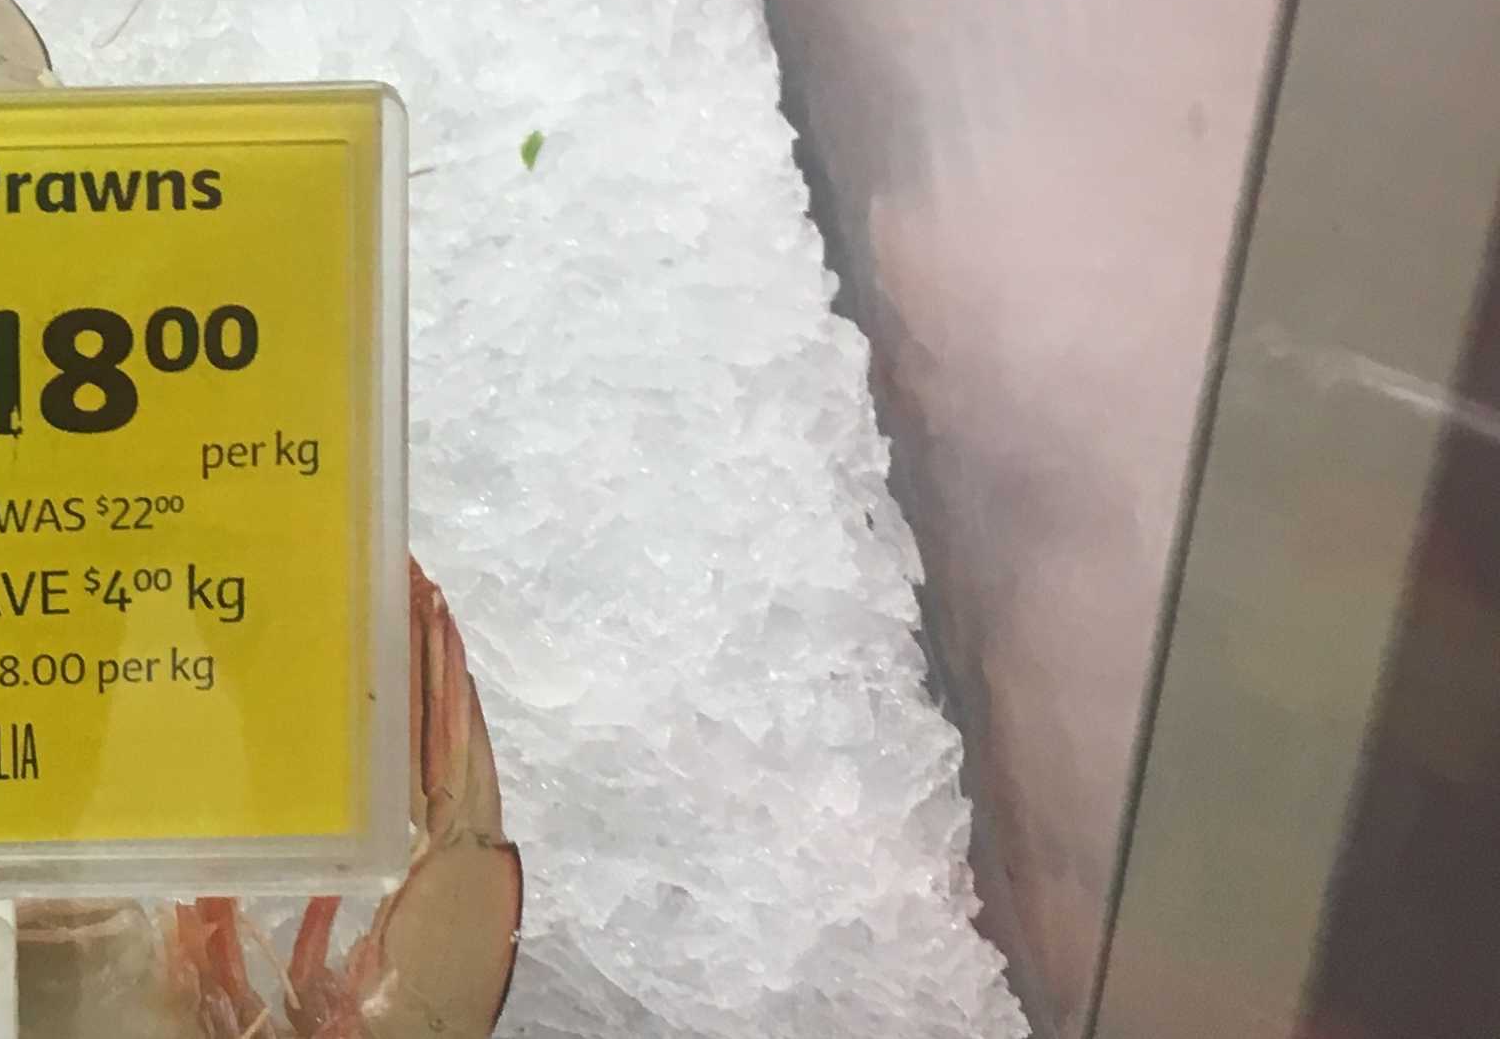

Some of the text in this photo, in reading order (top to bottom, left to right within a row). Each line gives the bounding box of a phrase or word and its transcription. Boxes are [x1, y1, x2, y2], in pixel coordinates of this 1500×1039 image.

[202, 430, 320, 480] per kg
[187, 563, 246, 624] kg
[97, 658, 160, 695] per
[171, 646, 214, 691] kg
